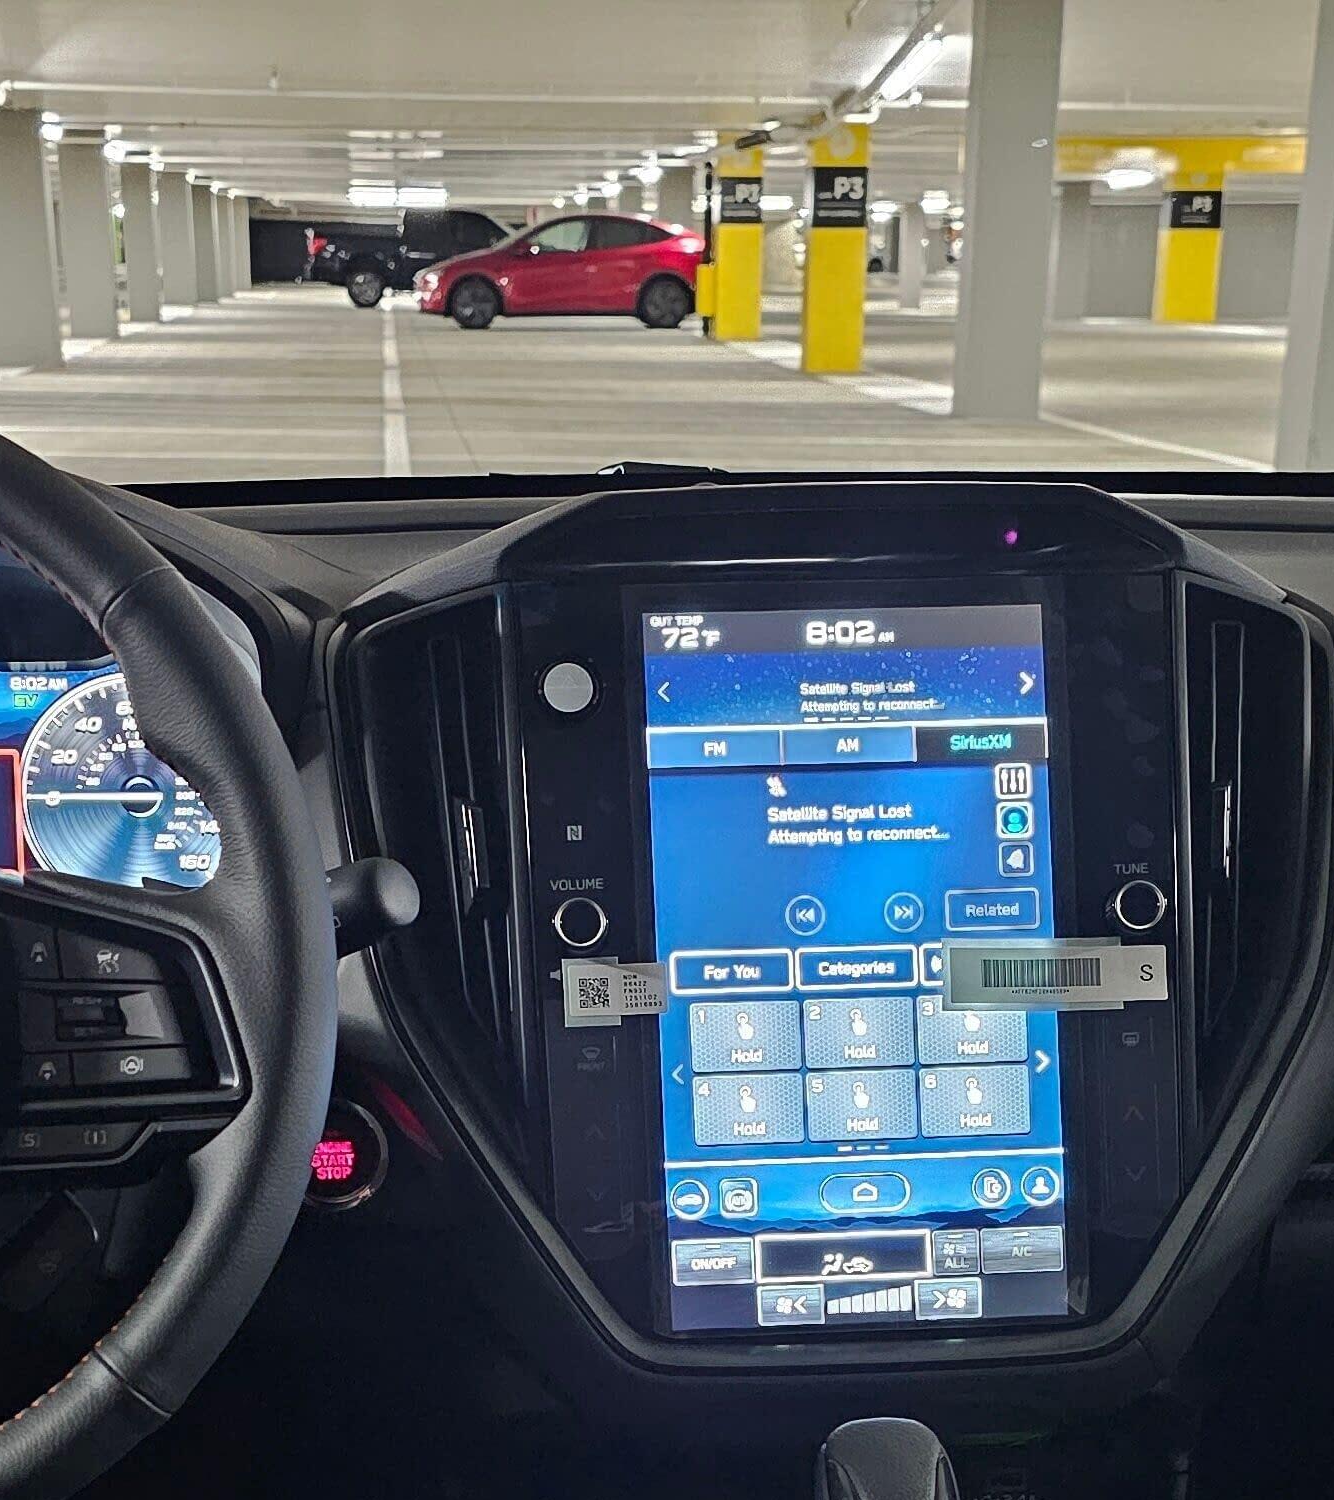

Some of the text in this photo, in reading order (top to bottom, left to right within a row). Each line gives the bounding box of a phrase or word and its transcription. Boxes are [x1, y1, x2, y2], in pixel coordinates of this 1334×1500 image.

[834, 176, 864, 200] P3
[649, 615, 704, 628] OUT TEMP
[805, 620, 895, 645] 8:02 AM
[10, 676, 68, 691] 8:02 AM
[799, 680, 916, 695] Satellite Signal Lost
[14, 694, 38, 707] EV
[800, 700, 859, 714] Attempting
[862, 700, 876, 711] to
[74, 716, 103, 733] 40
[704, 741, 727, 757] FM
[836, 738, 860, 753] AM
[949, 733, 1012, 751] SiriusXM
[51, 748, 79, 765] 20
[767, 803, 913, 823] Satellite Signal Lost
[767, 828, 843, 845] Attempting
[846, 827, 863, 841] to
[178, 854, 211, 870] 160
[1113, 862, 1150, 875] TUNE
[549, 877, 604, 891] VOLUME
[965, 902, 1020, 918] Related
[703, 964, 762, 981] For You
[818, 960, 896, 977] Categories
[1139, 964, 1154, 981] S
[808, 1005, 822, 1020] 2
[921, 1001, 934, 1016] 3
[696, 1010, 706, 1024] 1
[730, 1048, 763, 1063] Hold
[844, 1044, 877, 1059] Hold
[957, 1041, 989, 1055] Hold
[811, 1079, 824, 1094] 5
[924, 1074, 937, 1089] 6
[697, 1082, 711, 1097] 4
[846, 1117, 879, 1132] Hold
[959, 1112, 993, 1128] Hold
[733, 1121, 766, 1136] Hold
[311, 1153, 355, 1168] START
[316, 1166, 353, 1180] STOP
[1010, 1245, 1033, 1258] A/C
[690, 1256, 738, 1271] ON/OFF
[943, 1257, 970, 1271] ALL
